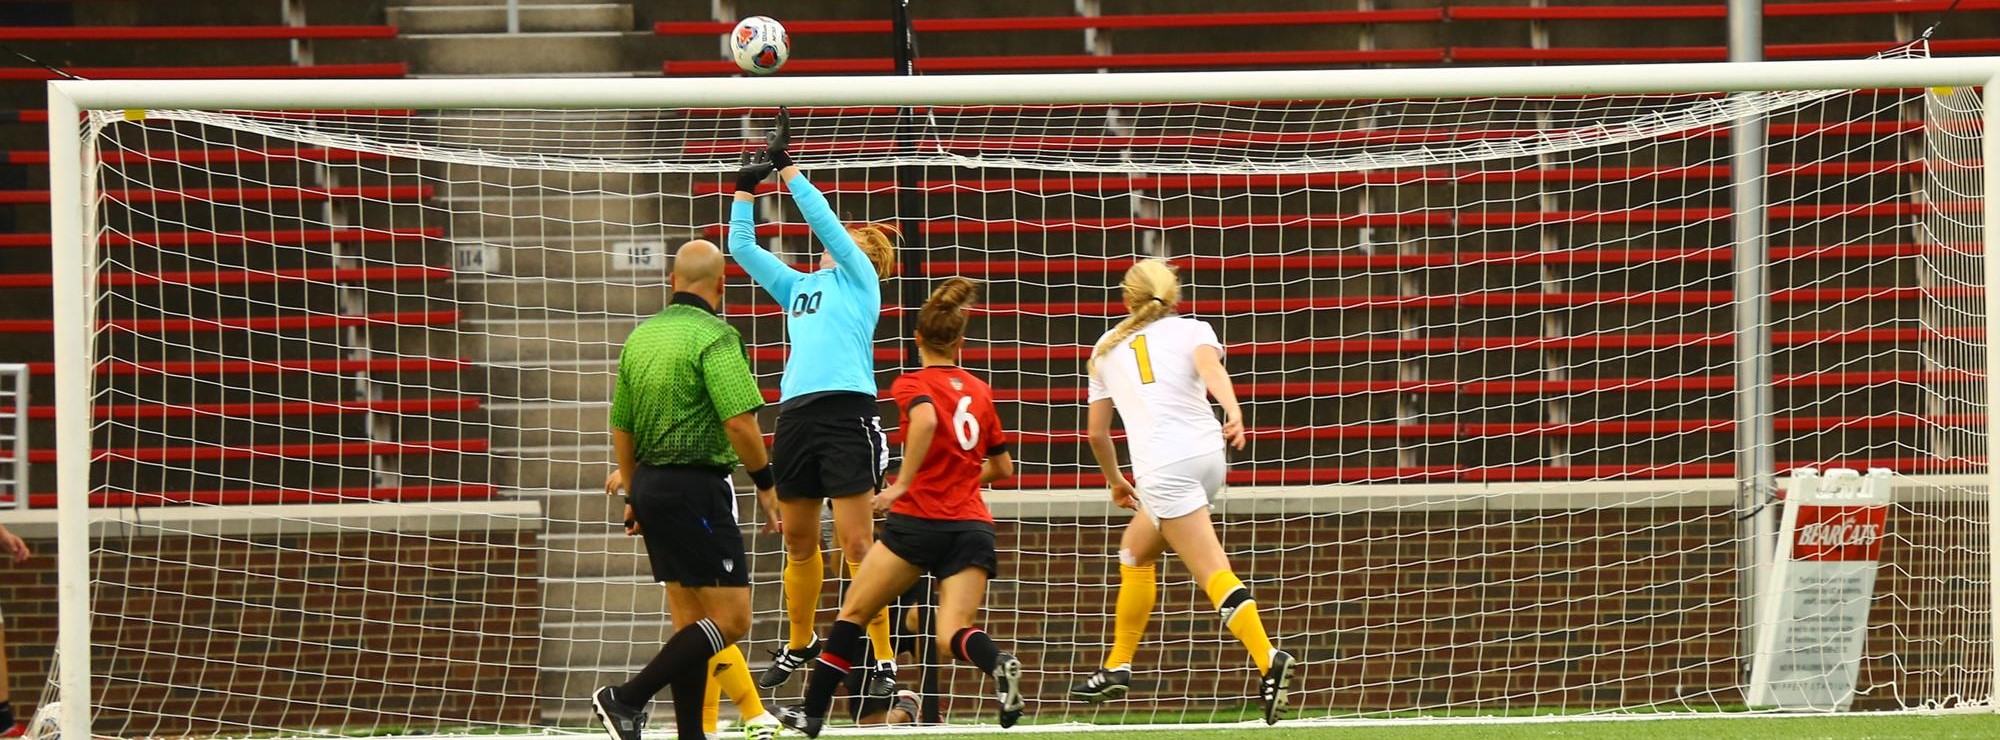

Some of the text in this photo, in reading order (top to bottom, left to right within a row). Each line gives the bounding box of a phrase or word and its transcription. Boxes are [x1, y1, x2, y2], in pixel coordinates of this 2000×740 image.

[459, 250, 483, 266] 114
[628, 247, 651, 265] 115
[792, 290, 823, 318] 00
[1129, 334, 1156, 385] 1
[952, 395, 980, 451] 6
[1797, 524, 1880, 546] BEARCATS
